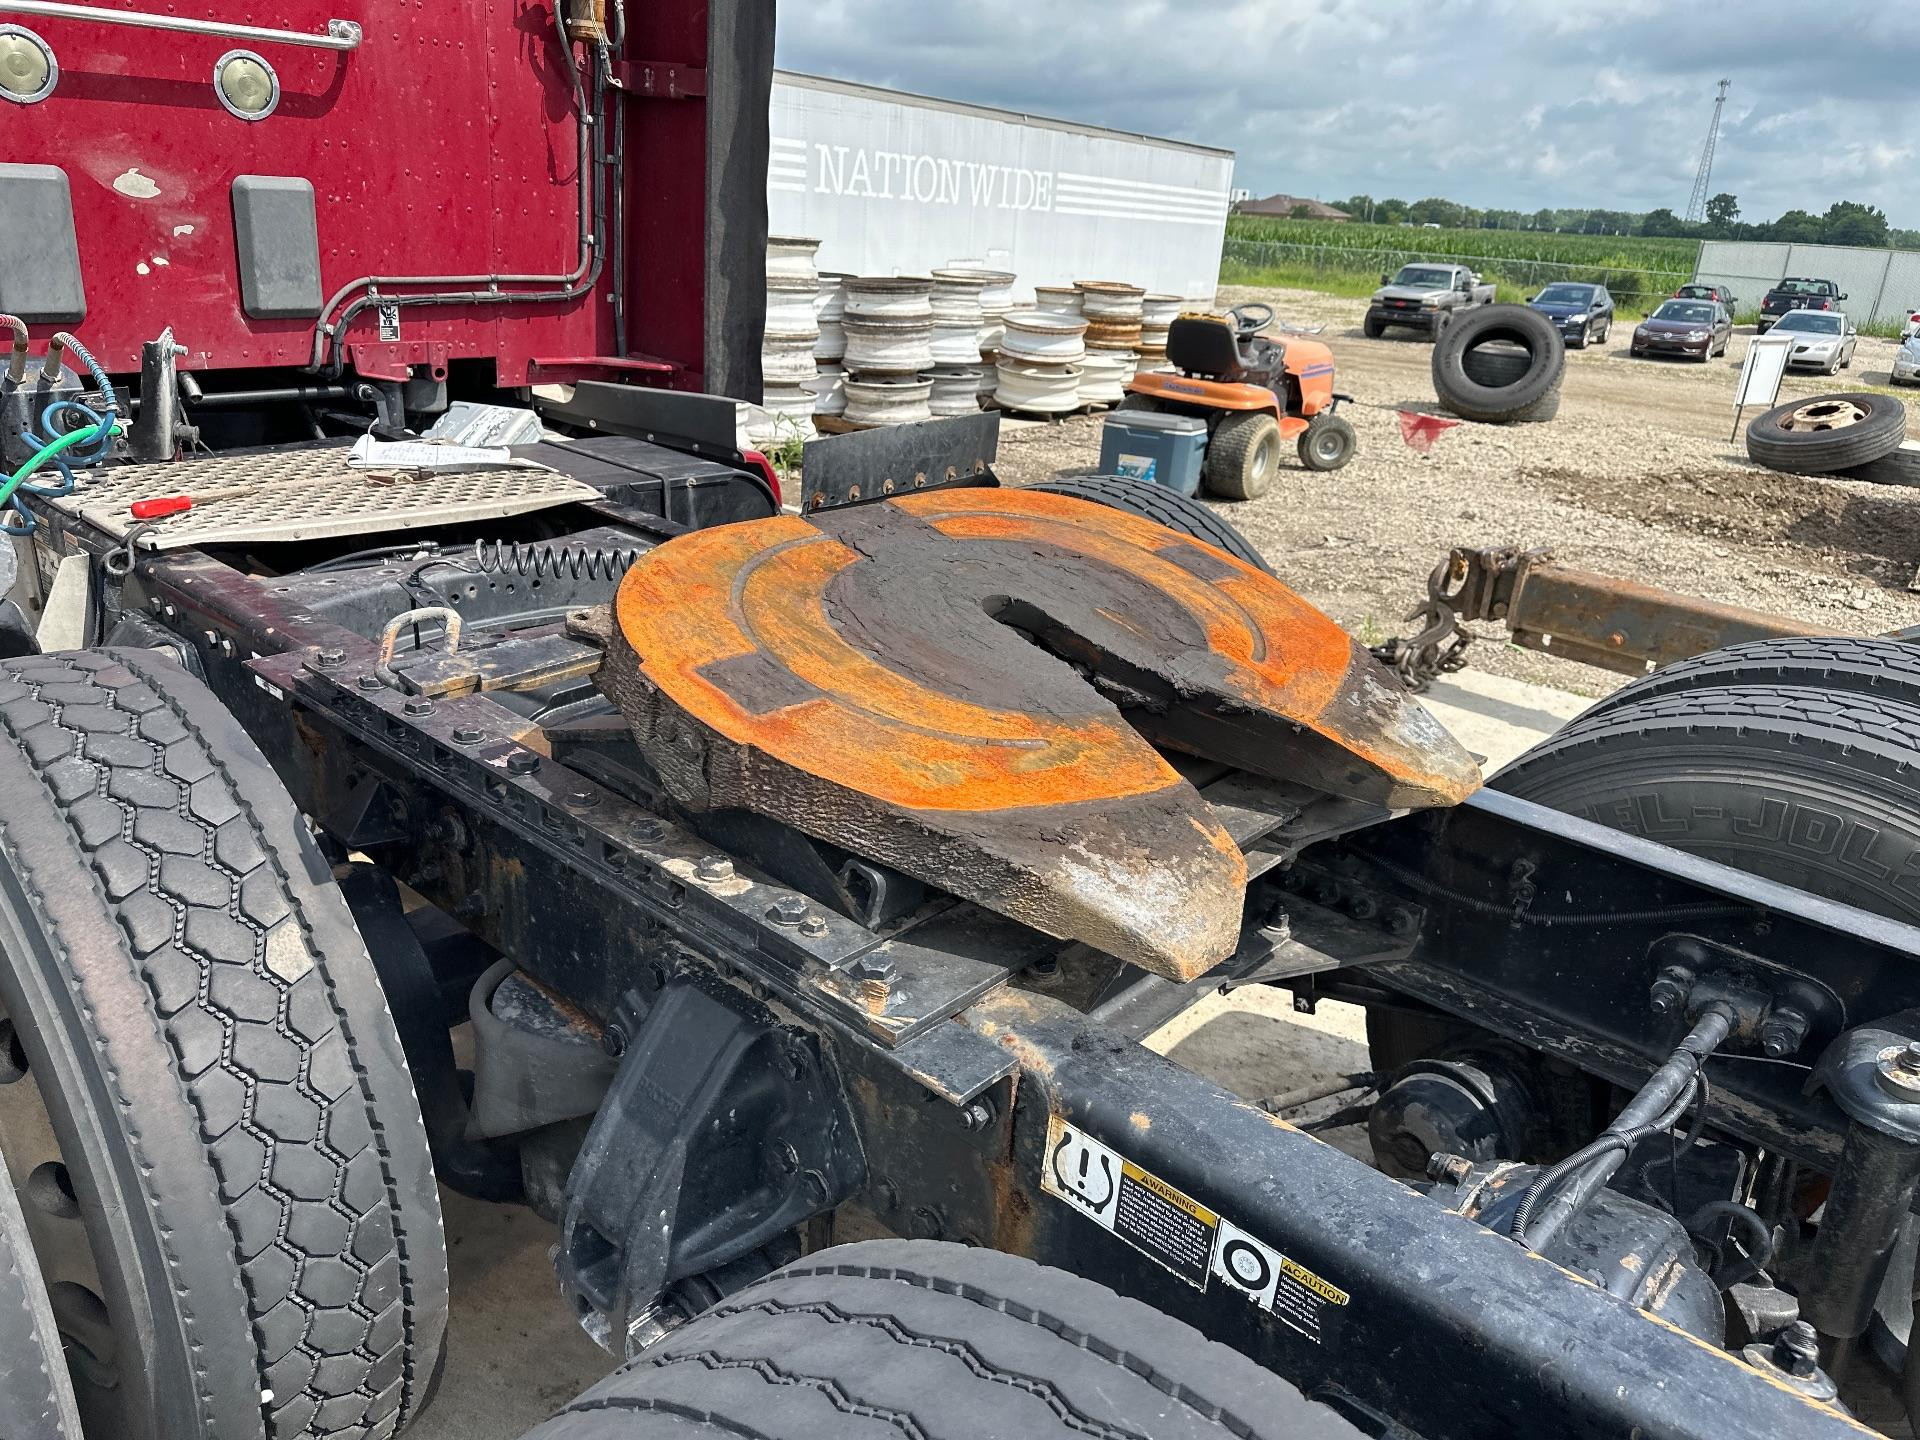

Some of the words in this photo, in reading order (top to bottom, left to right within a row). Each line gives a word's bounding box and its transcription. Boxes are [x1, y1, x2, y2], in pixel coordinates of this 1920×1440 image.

[1122, 1184, 1133, 1193] part
[1173, 1214, 1181, 1223] the
[1123, 1177, 1133, 1187] Use
[1134, 1185, 1145, 1196] only
[1146, 1191, 1154, 1200] the
[1155, 1198, 1170, 1210] wheel
[1189, 1218, 1199, 1228] size
[1149, 1179, 1196, 1214] WARNING
[1142, 1209, 1157, 1222] wheel
[1158, 1218, 1173, 1232] brand
[1185, 1228, 1195, 1239] Use
[1192, 1248, 1203, 1258] with
[1191, 1261, 1202, 1270] and
[1281, 1274, 1304, 1292] Maintain
[1292, 1268, 1343, 1305] CAUTION
